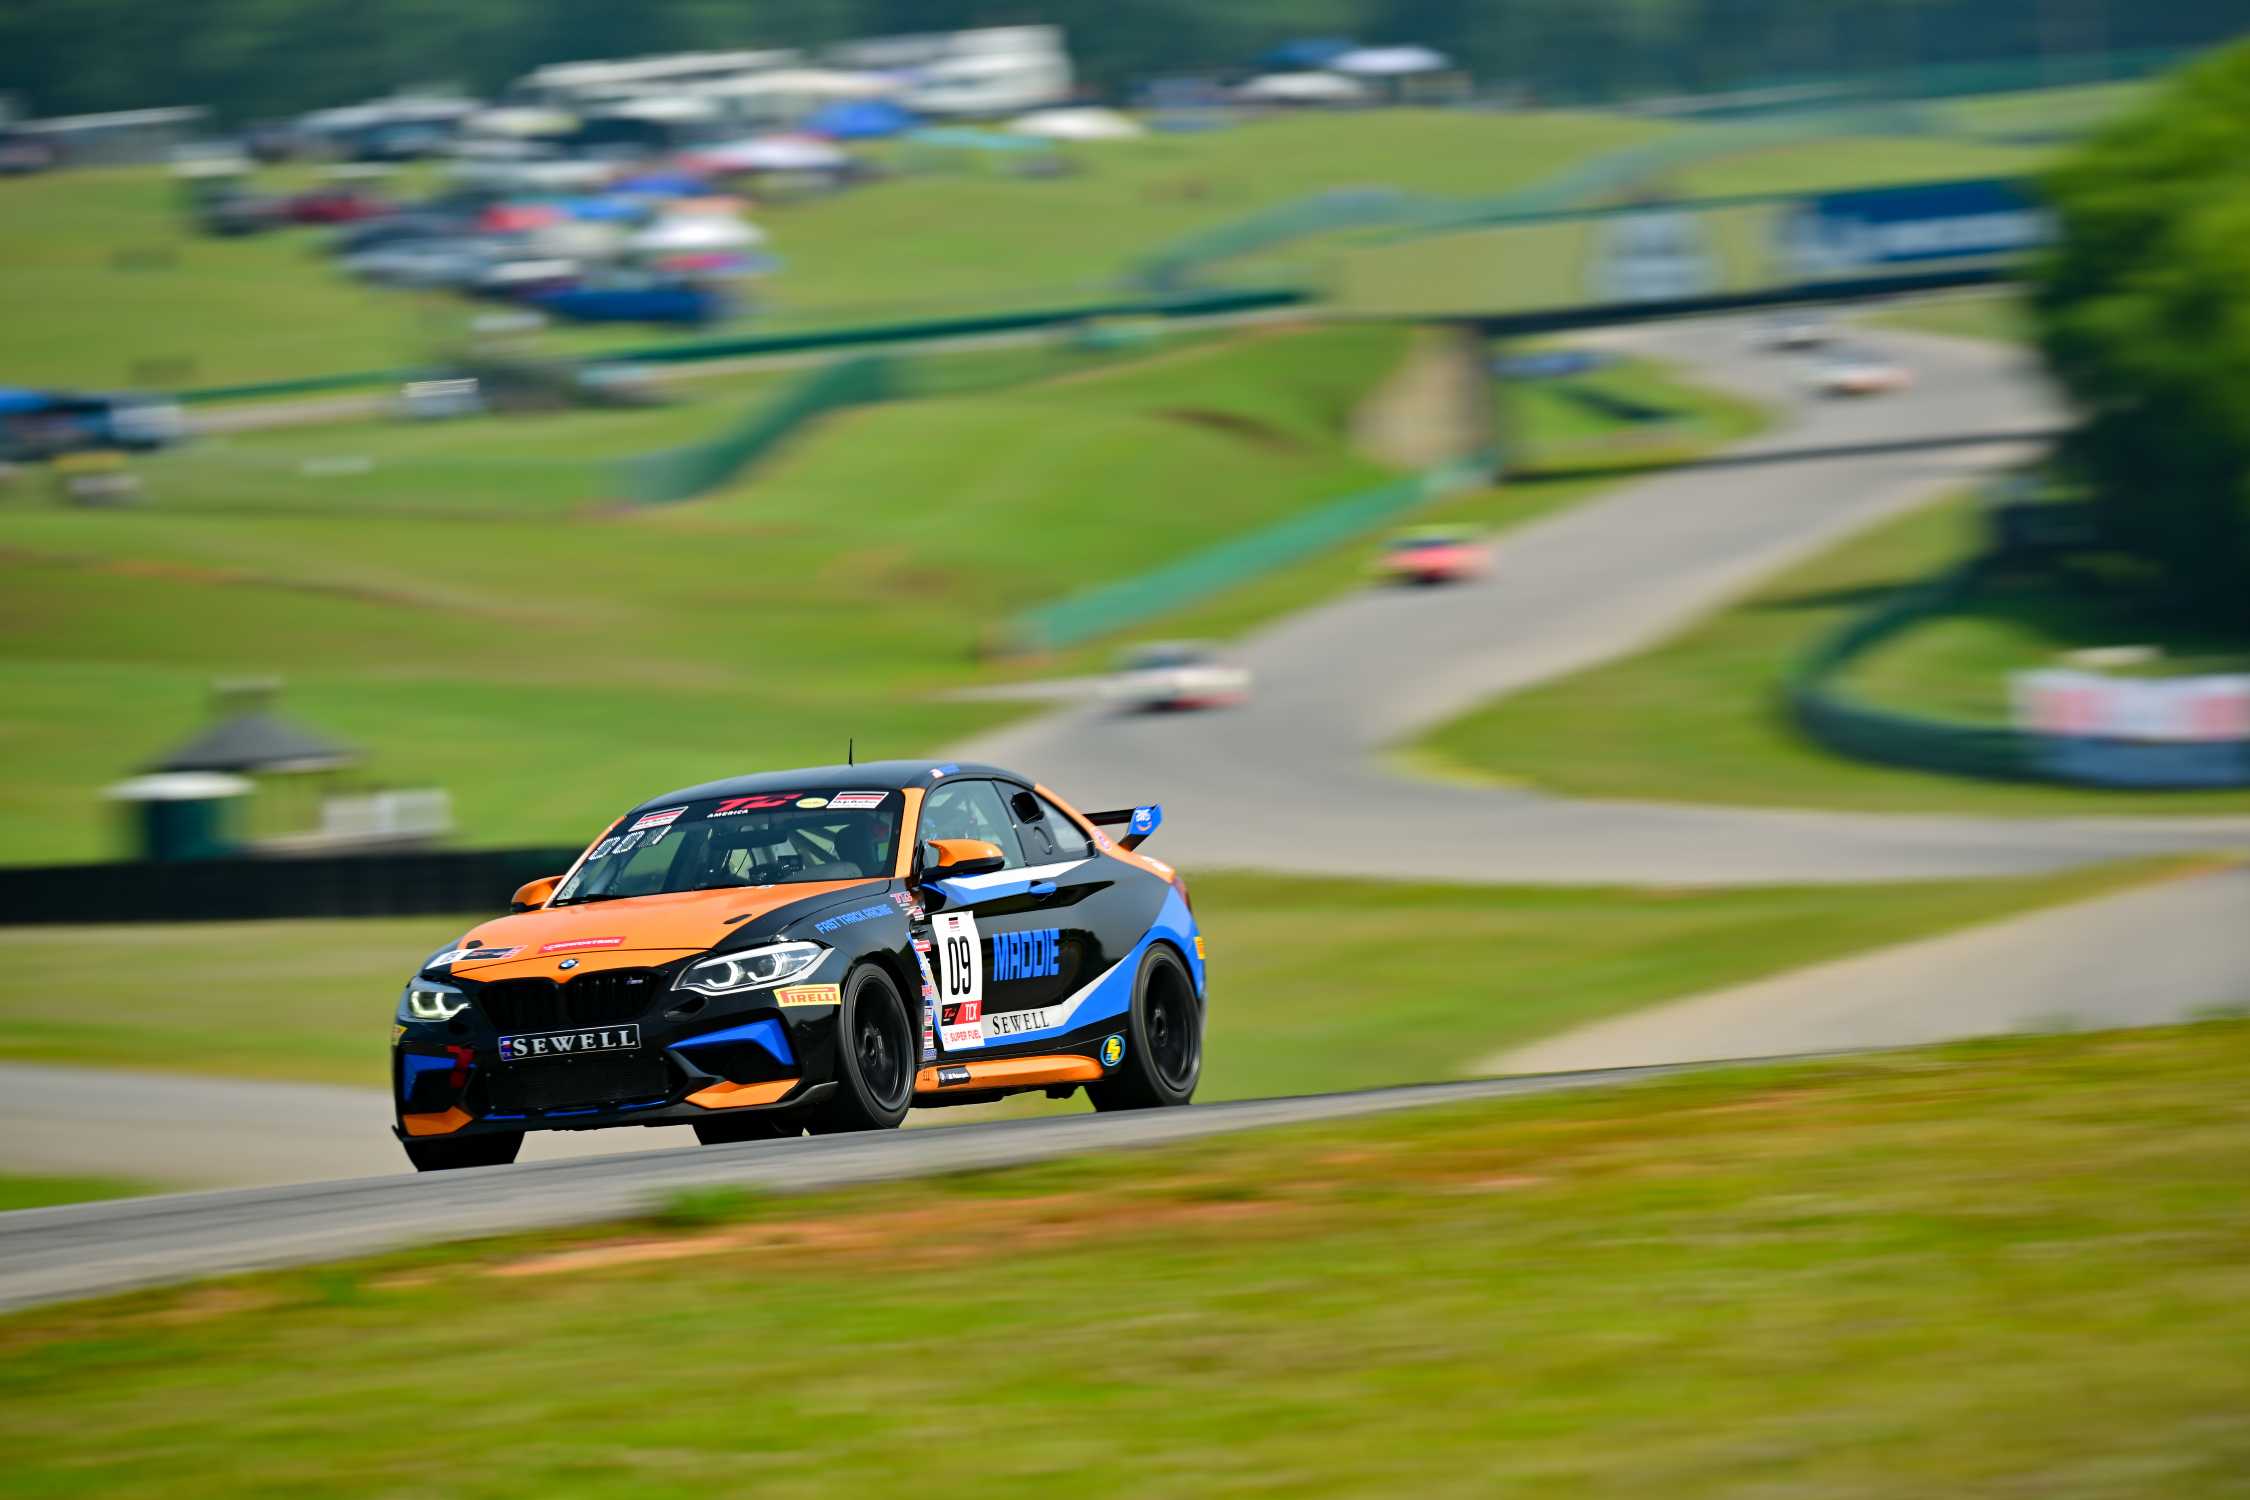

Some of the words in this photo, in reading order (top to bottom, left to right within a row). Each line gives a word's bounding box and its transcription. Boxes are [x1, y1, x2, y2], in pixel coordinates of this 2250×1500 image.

[706, 809, 749, 818] AMERICA
[815, 916, 841, 935] FAST
[837, 910, 868, 926] TRACK
[947, 936, 972, 995] 09
[992, 928, 1060, 981] MADDIE
[779, 986, 838, 1004] PIRELLI
[965, 1003, 978, 1022] TCX
[992, 1011, 1050, 1035] SEWELL
[512, 1030, 636, 1057] SEWELL
[949, 1030, 967, 1043] SUPER
[968, 1028, 982, 1041] FUEL
